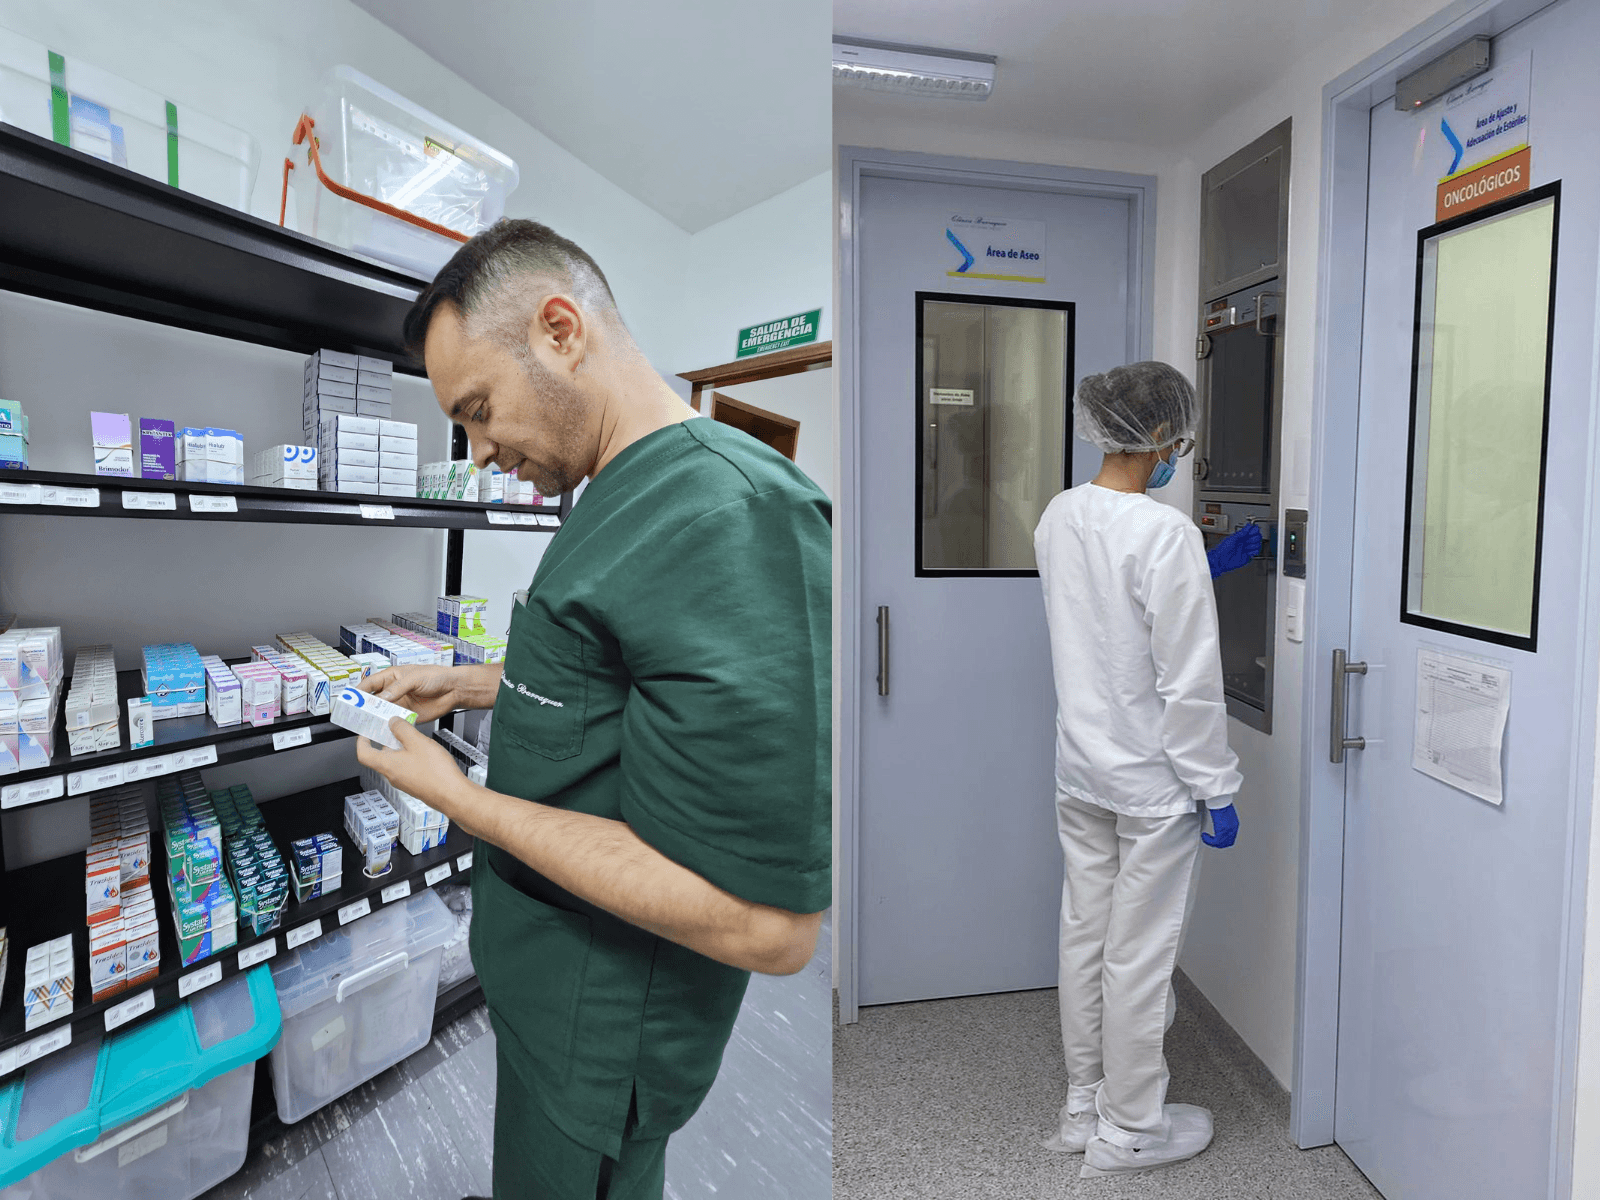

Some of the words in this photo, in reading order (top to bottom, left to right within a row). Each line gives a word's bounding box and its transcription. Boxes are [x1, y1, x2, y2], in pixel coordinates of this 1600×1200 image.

[1488, 113, 1496, 123] de
[1496, 105, 1513, 120] Ajuste
[1495, 125, 1503, 135] de
[1444, 165, 1520, 208] ONCOLÓGICOS
[986, 245, 1006, 258] Área
[1007, 249, 1018, 259] de
[1019, 250, 1040, 260] Aseo
[750, 320, 789, 337] SALIDA
[791, 315, 806, 328] DE
[742, 323, 812, 348] EMERGENCIA
[193, 861, 218, 875] Systane
[301, 862, 320, 874] Systane
[258, 894, 280, 909] Systane
[182, 916, 209, 932] Systane
